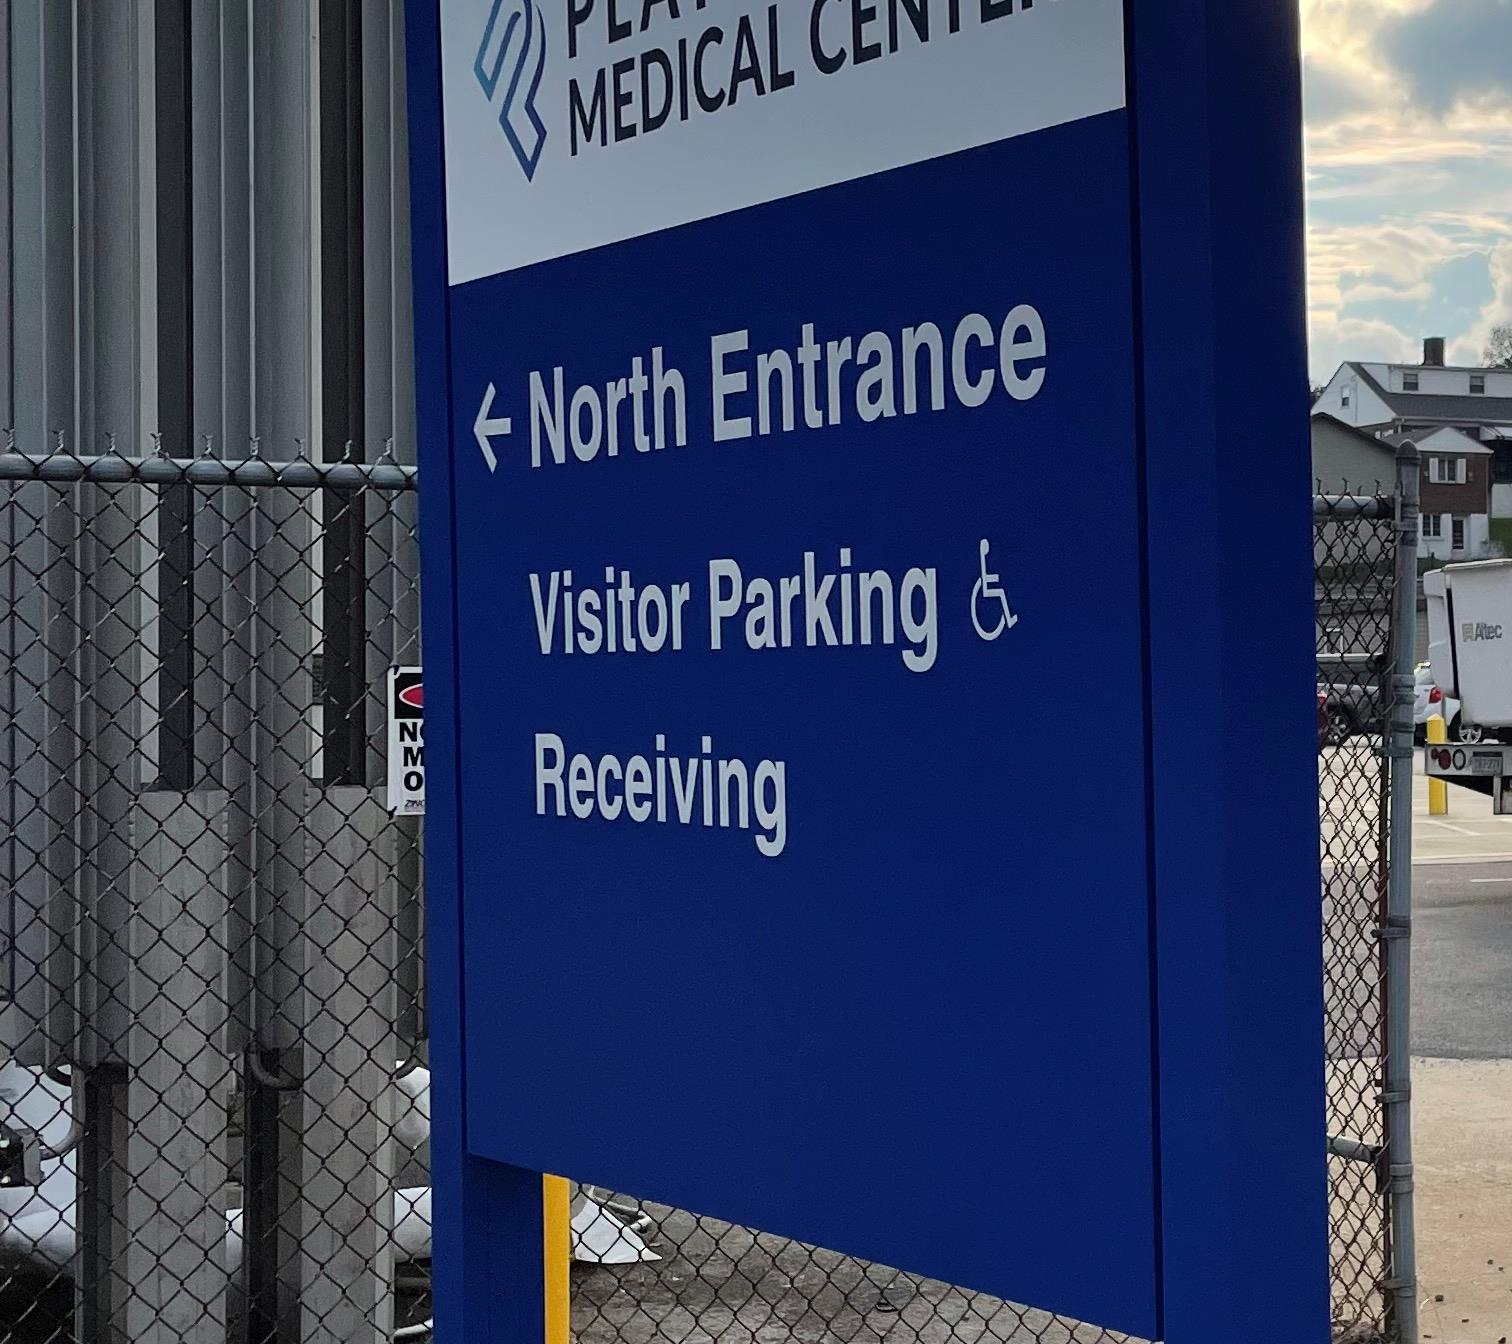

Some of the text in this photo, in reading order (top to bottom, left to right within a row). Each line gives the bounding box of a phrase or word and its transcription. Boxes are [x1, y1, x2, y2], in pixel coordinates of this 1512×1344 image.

[568, 2, 796, 157] MEDICAL
[529, 304, 1047, 468] North Entrance
[528, 547, 938, 673] Visitor Parking
[399, 721, 424, 743] N
[534, 733, 787, 857] Receiving
